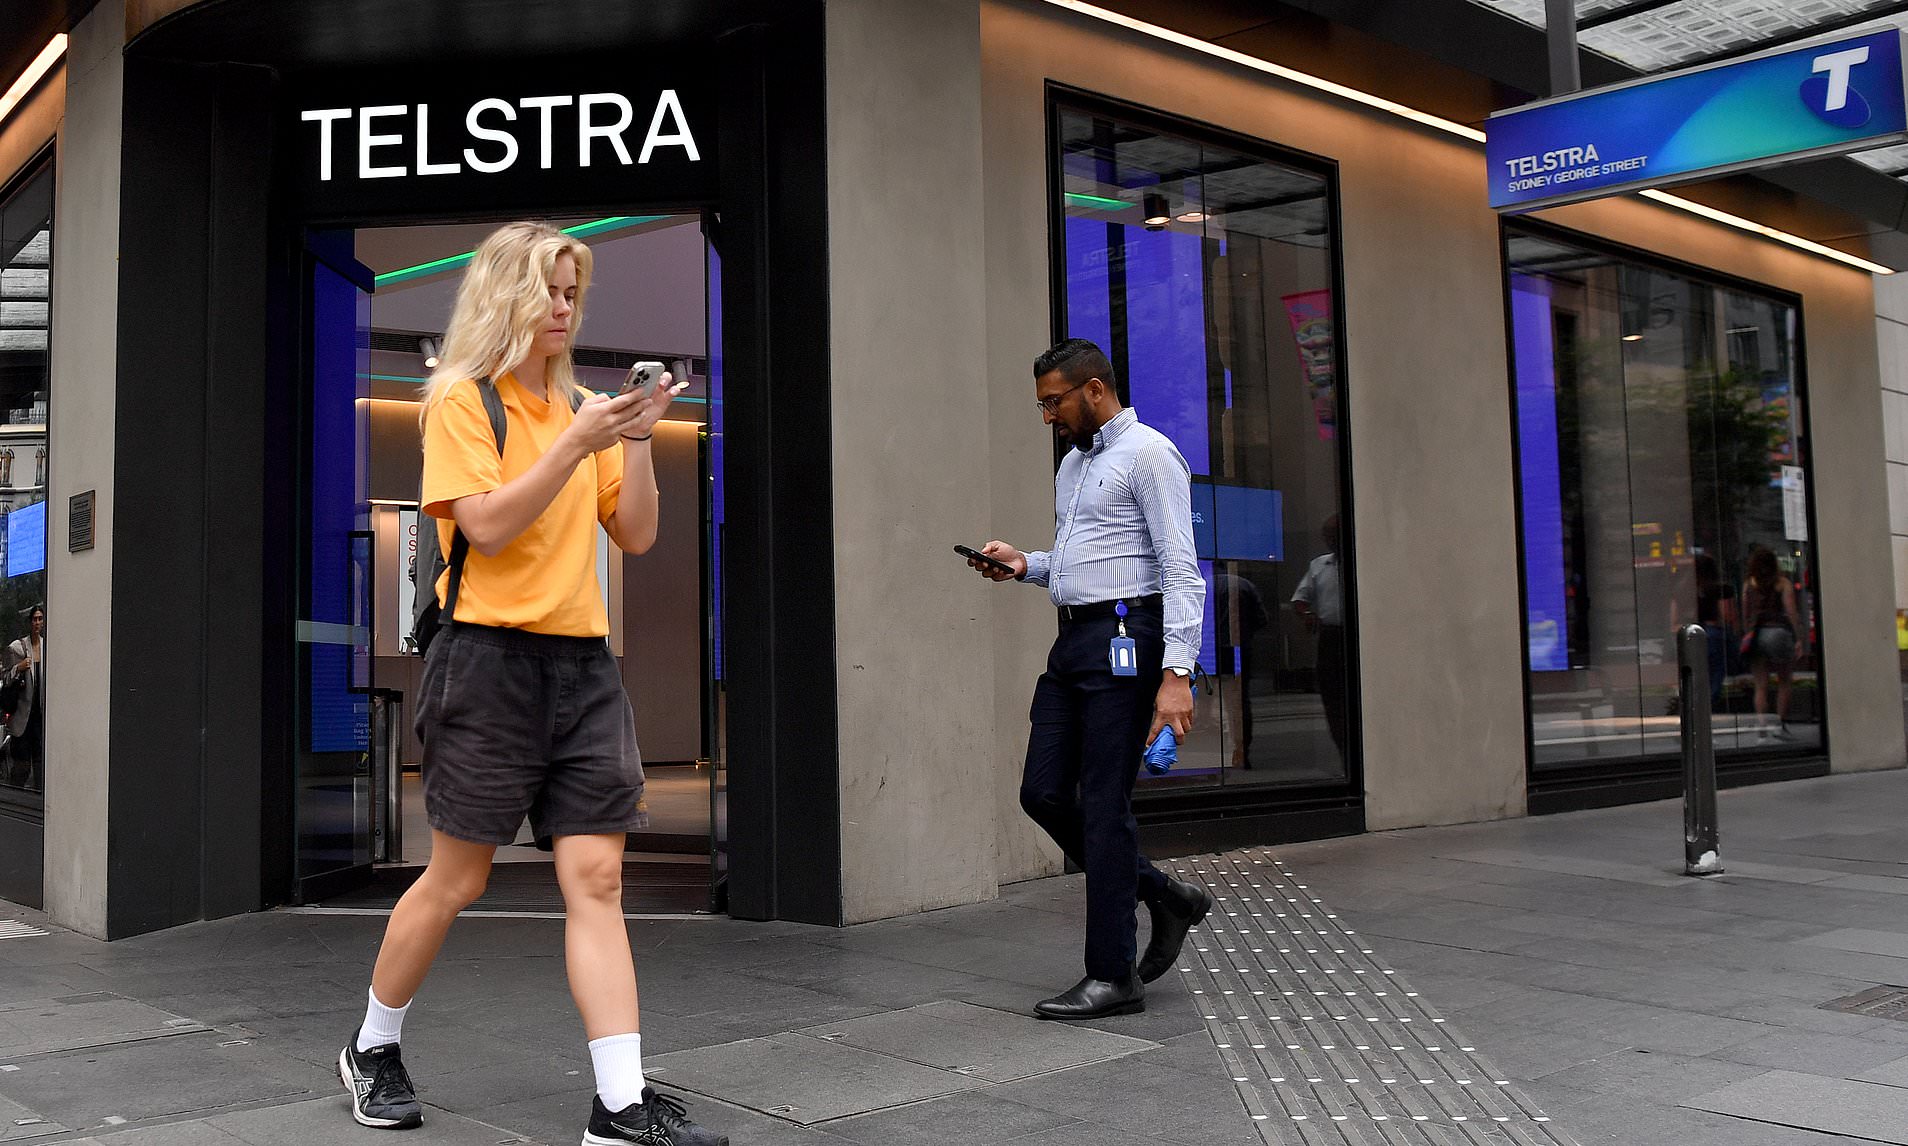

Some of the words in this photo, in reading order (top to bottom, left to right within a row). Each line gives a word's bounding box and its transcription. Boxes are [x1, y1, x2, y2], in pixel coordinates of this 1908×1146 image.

[1812, 46, 1869, 111] T
[301, 89, 701, 181] TELSTRA
[1506, 144, 1599, 178] TELSTRA
[1508, 174, 1553, 193] SYDNEY
[1554, 165, 1600, 184] GEORGE
[1602, 156, 1648, 174] STREET
